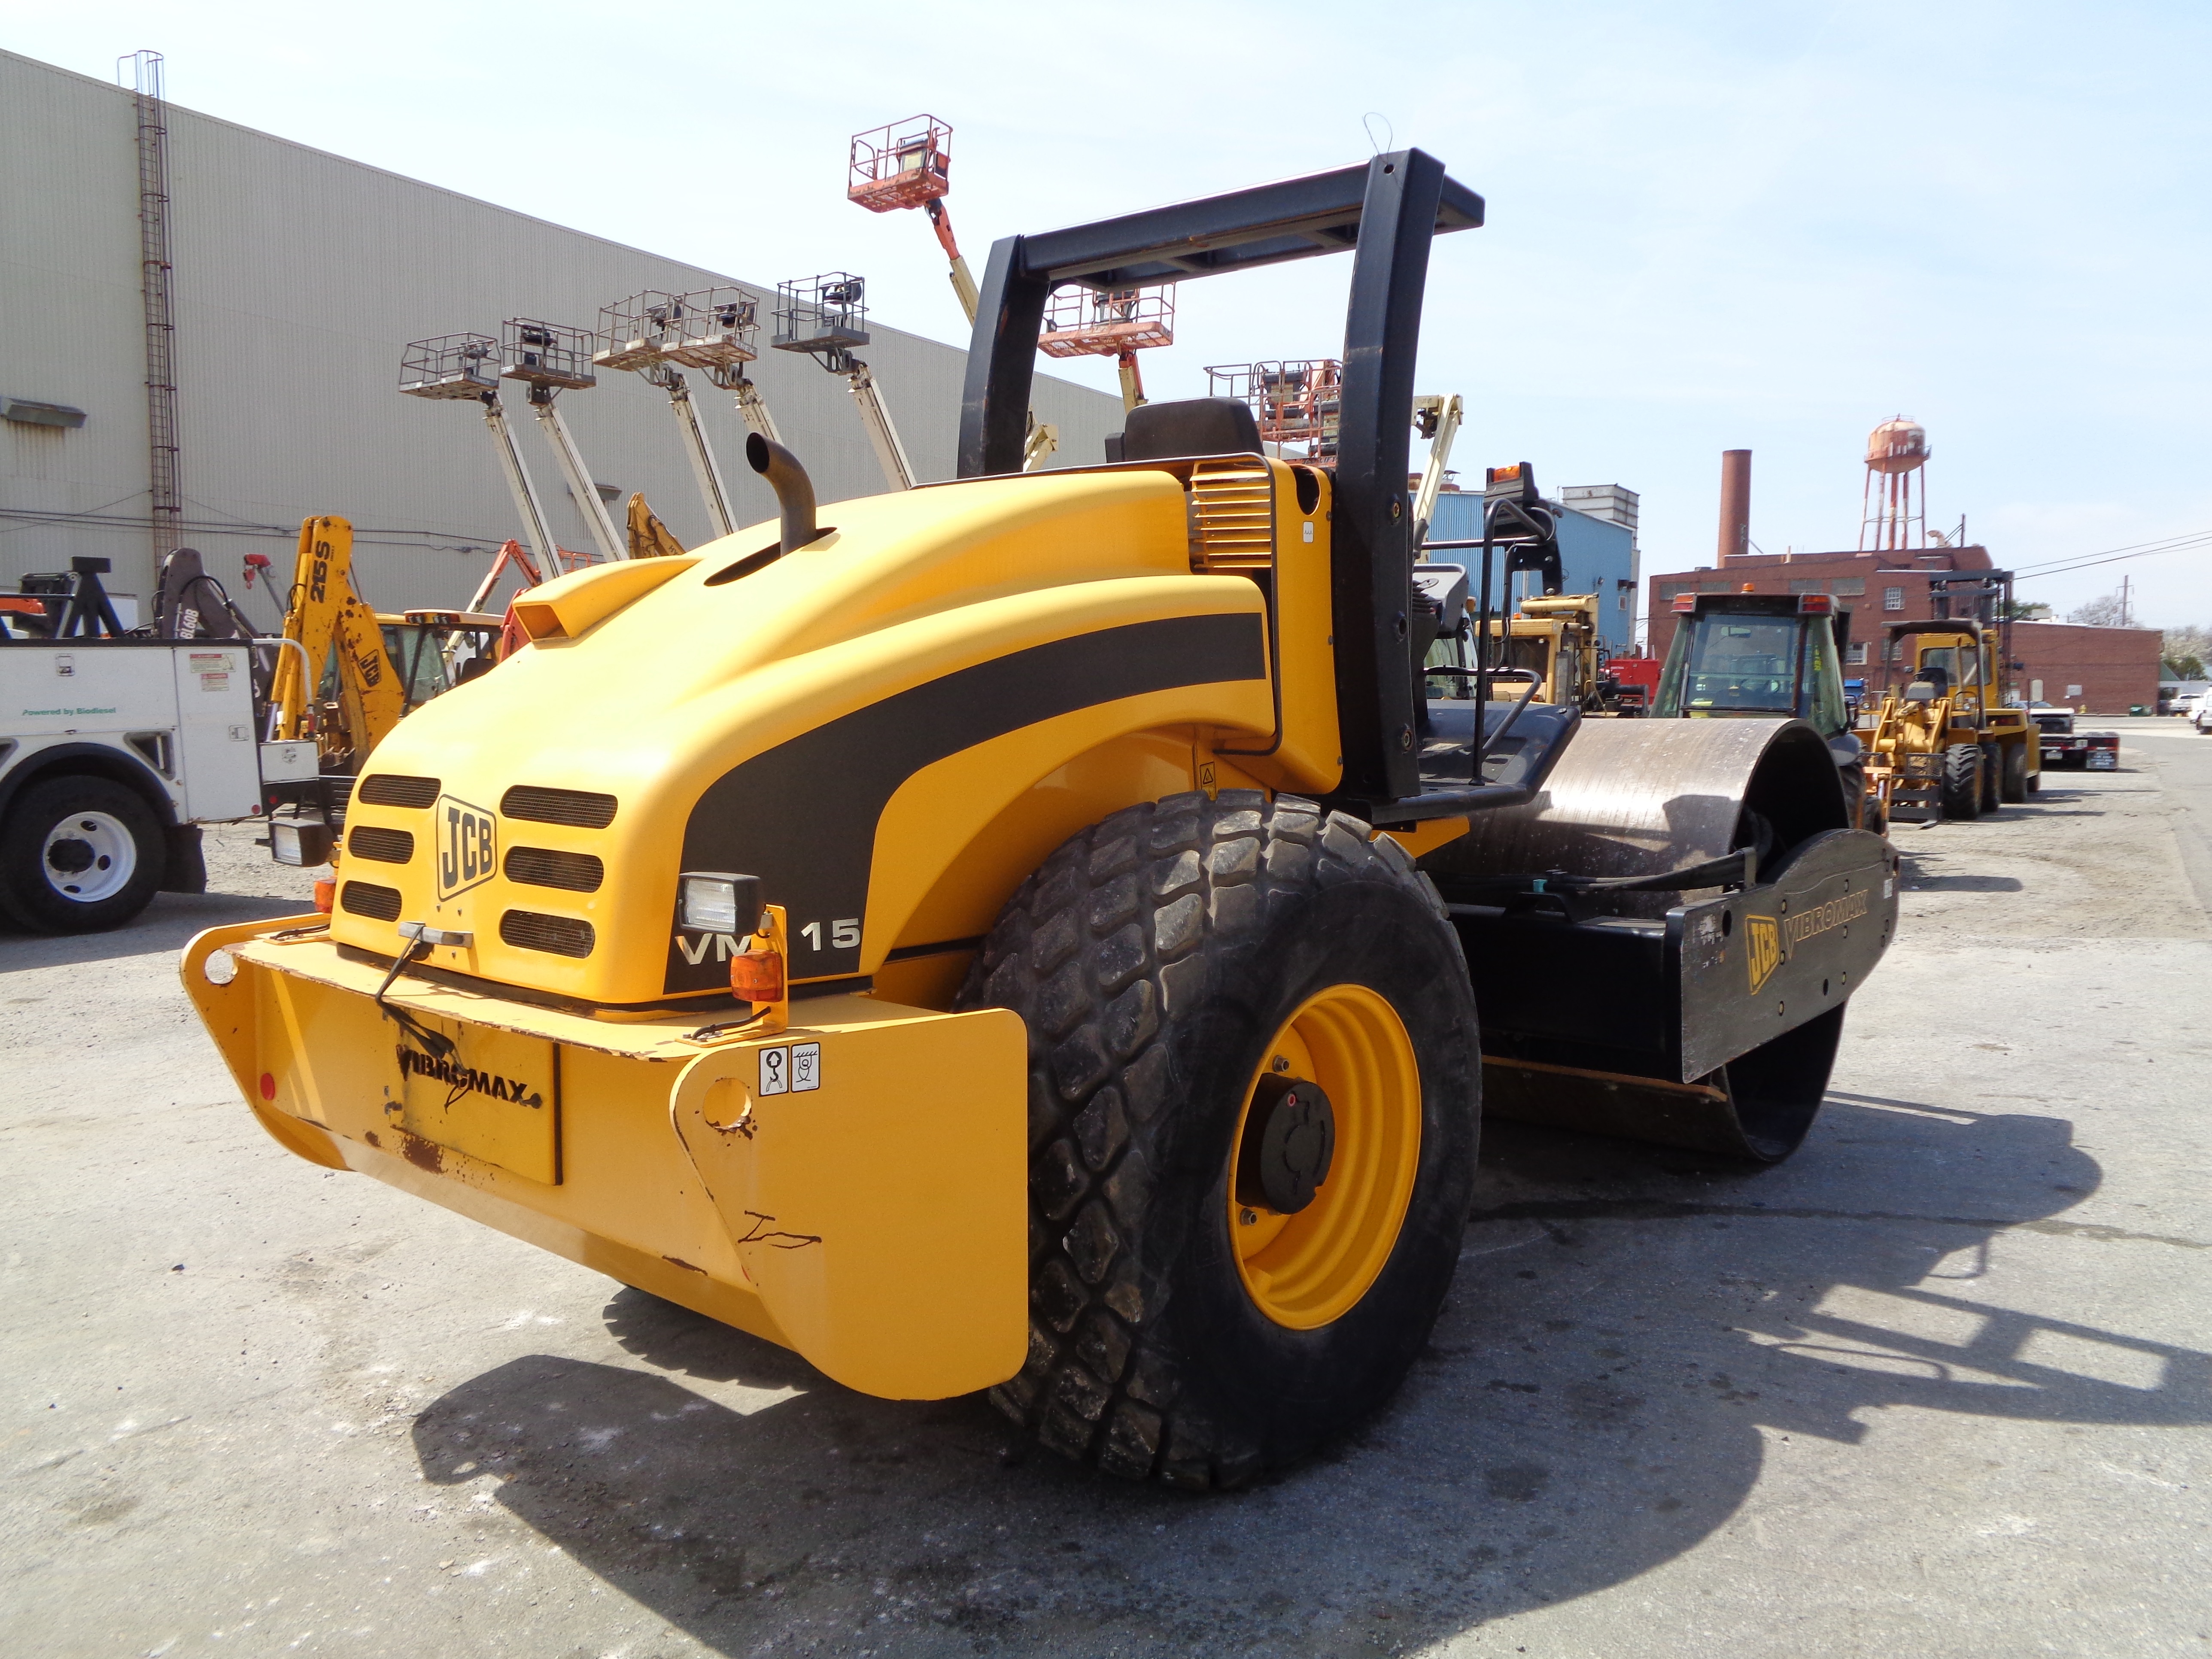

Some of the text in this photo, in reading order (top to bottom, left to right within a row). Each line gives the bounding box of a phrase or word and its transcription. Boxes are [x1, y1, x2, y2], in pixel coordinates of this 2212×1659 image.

[179, 608, 199, 639] BL60B
[360, 654, 379, 687] JCB
[443, 807, 493, 889] JCB
[801, 918, 860, 951] 15
[1784, 889, 1868, 960] VIBROMAX
[1750, 923, 1777, 986] JCB
[396, 1044, 527, 1103] VIBROMAX
